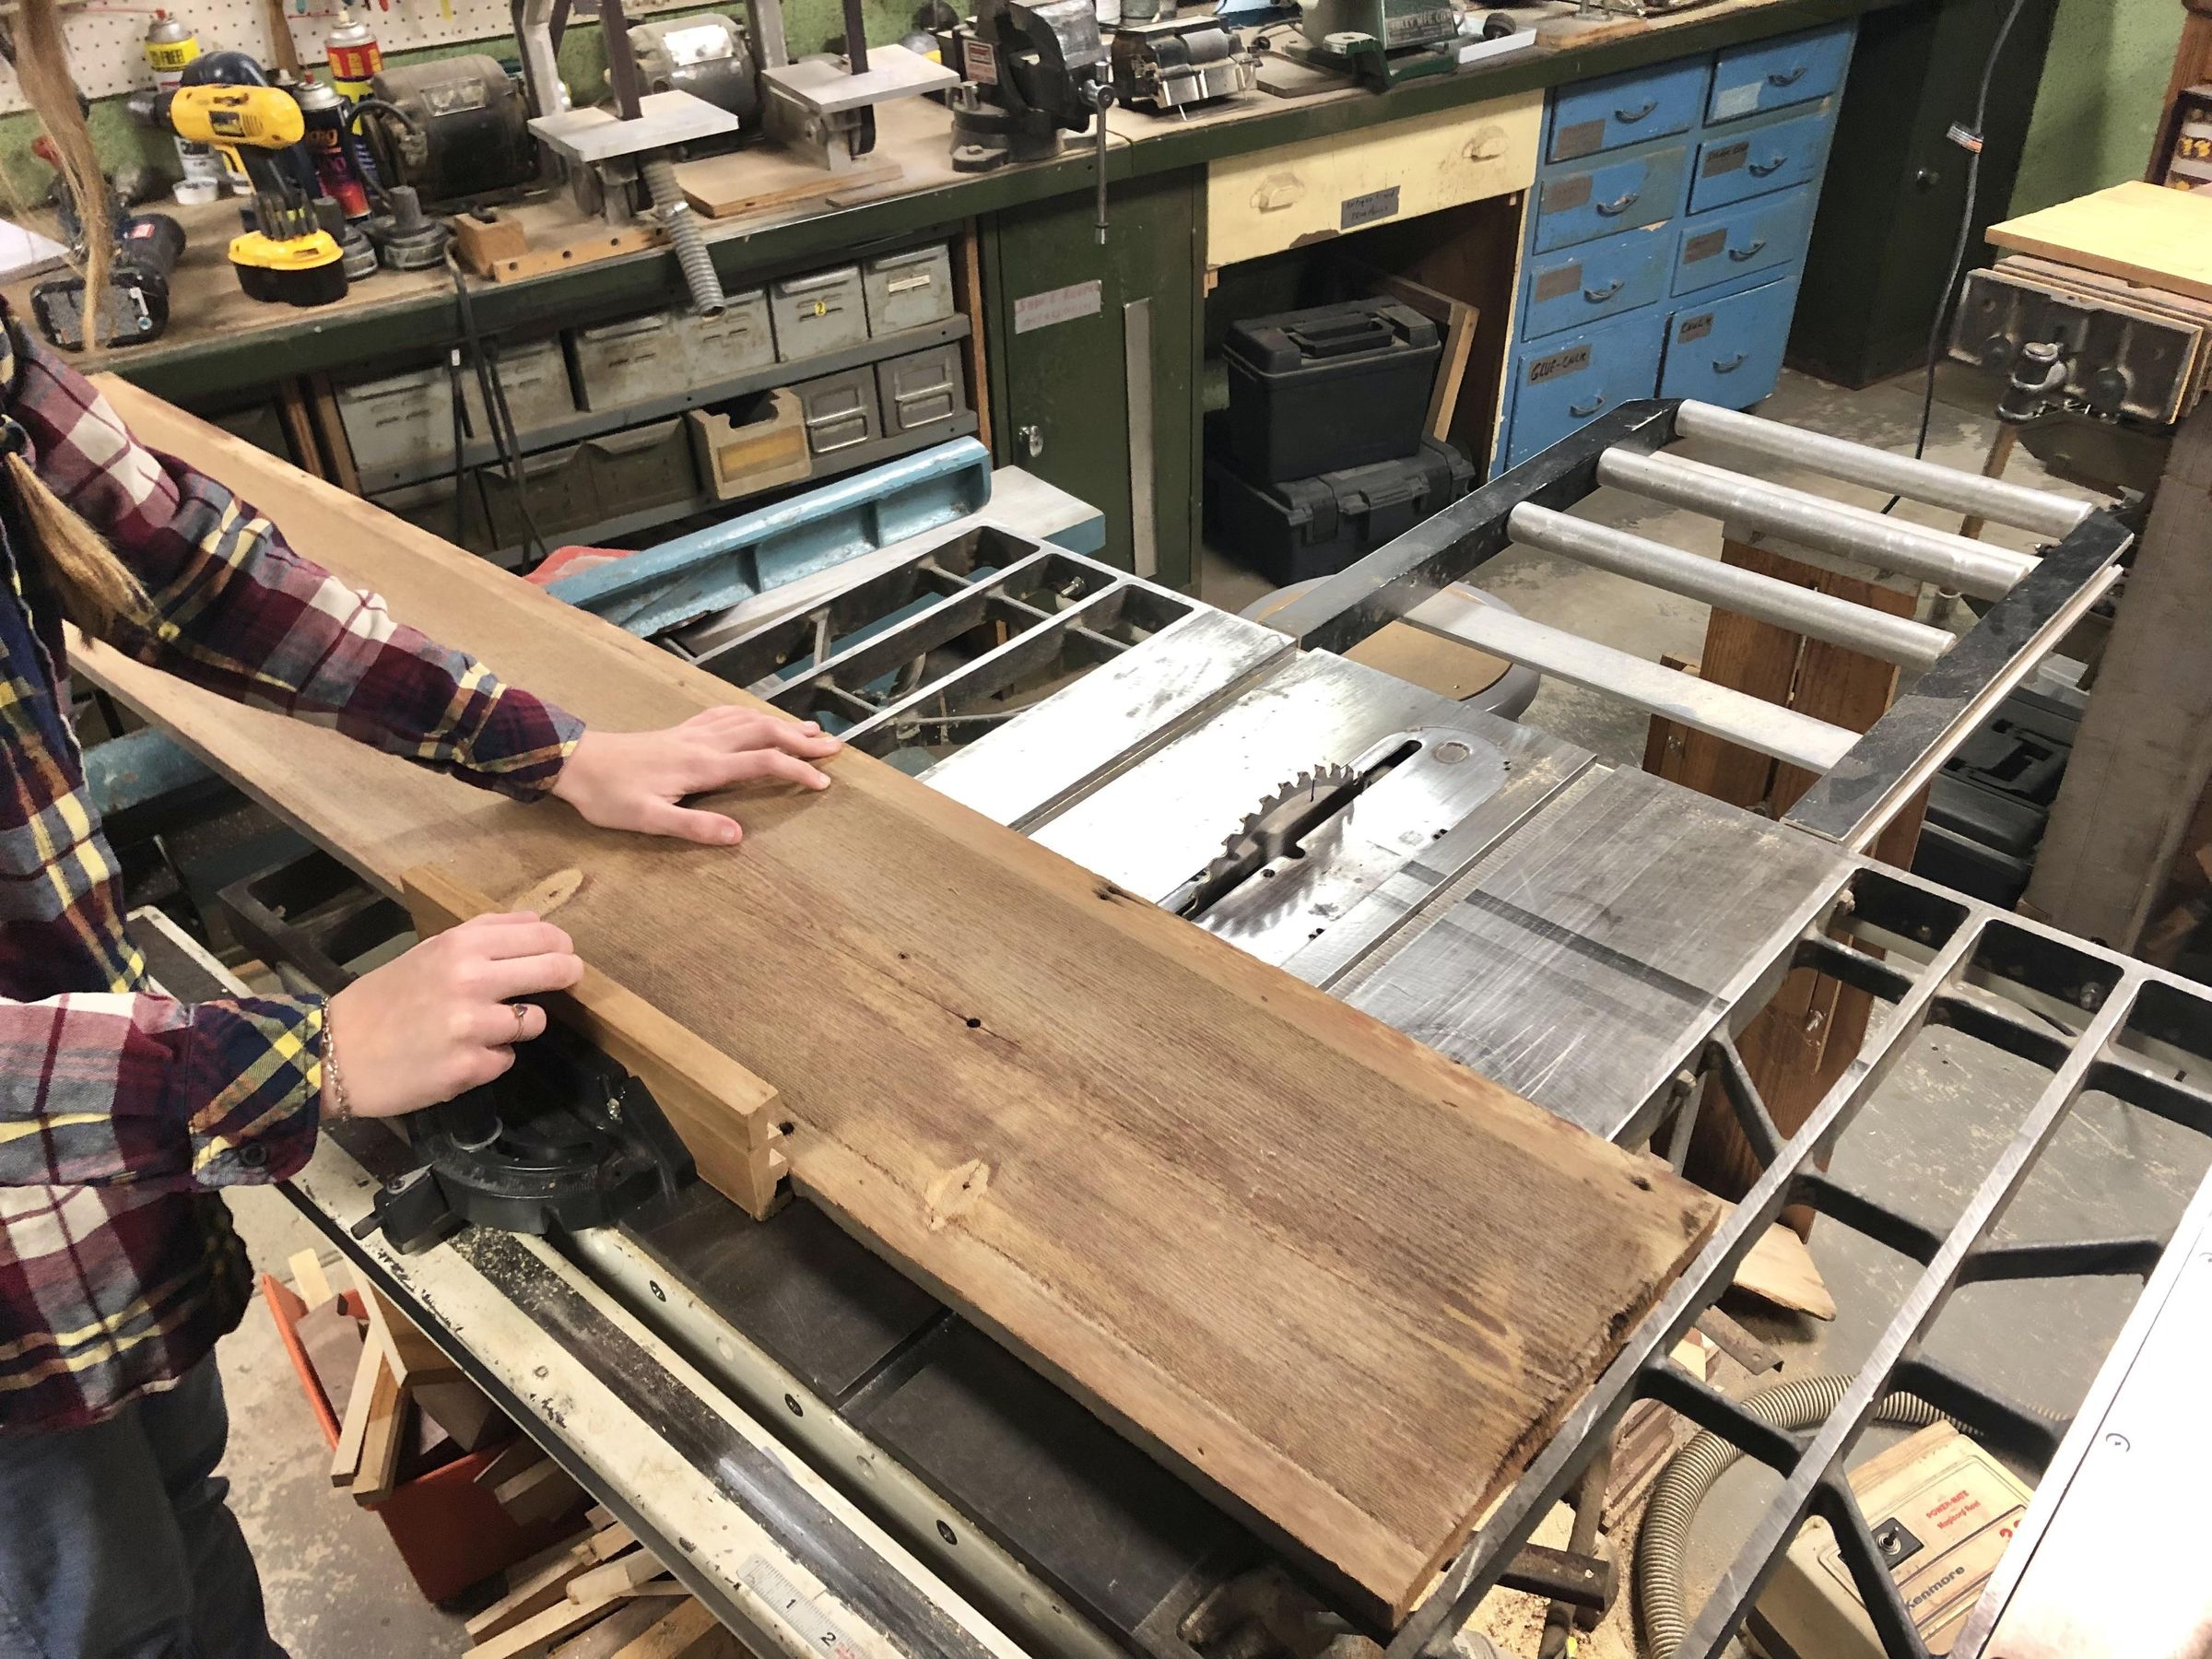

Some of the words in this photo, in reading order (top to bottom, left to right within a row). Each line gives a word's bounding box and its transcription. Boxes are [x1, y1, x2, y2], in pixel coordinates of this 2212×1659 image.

[1904, 1566, 1966, 1609] Kenmore
[785, 1598, 796, 1609] 1
[820, 1631, 837, 1647] 2
